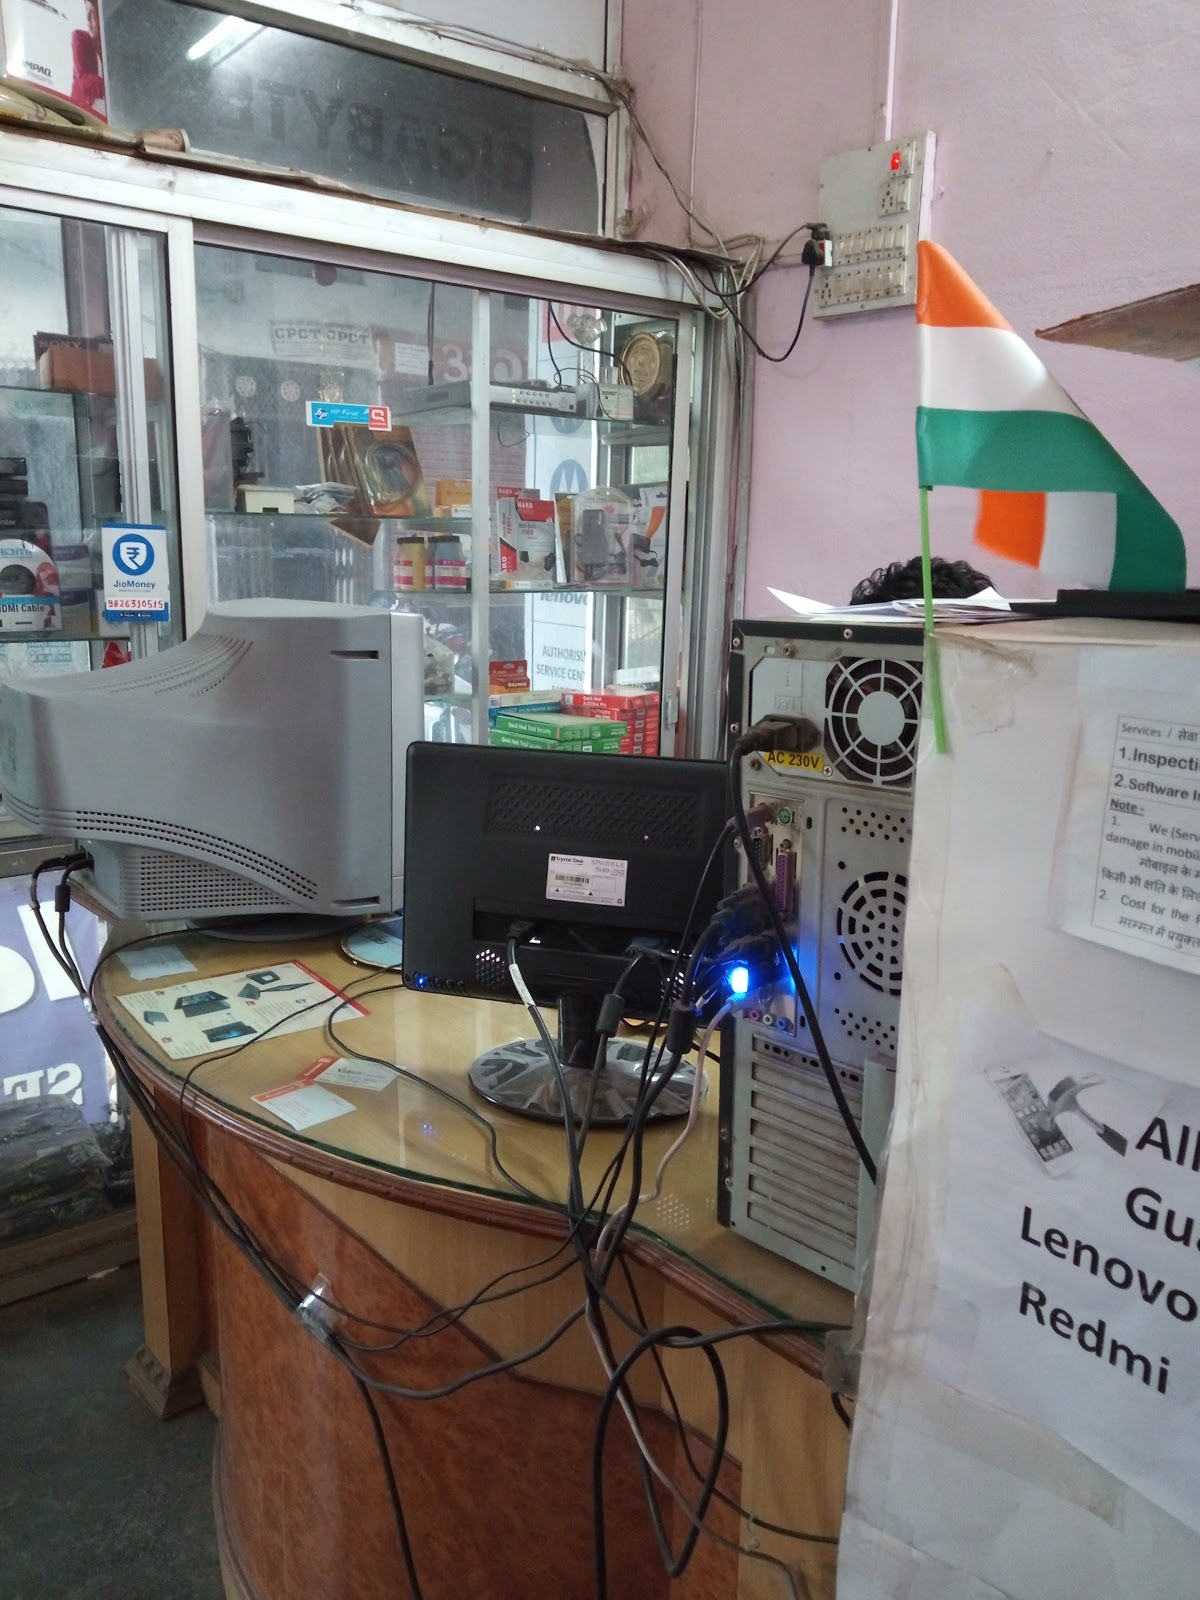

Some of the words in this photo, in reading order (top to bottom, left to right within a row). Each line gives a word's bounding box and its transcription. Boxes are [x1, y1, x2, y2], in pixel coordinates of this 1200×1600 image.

[23, 60, 52, 77] MPAQ
[39, 340, 81, 350] SONY
[113, 580, 156, 589] JioMoney
[0, 604, 19, 612] DMI
[22, 603, 45, 612] Cable
[536, 663, 566, 679] SERVICE
[1121, 723, 1161, 738] Services
[767, 752, 785, 764] AC
[788, 753, 820, 769] 230V
[1120, 746, 1200, 771] 1.Inspecti
[1110, 798, 1138, 813] Note
[1149, 822, 1168, 836] We
[1106, 832, 1150, 850] damage
[1152, 841, 1163, 853] in
[1166, 847, 1200, 861] mobil
[1121, 895, 1146, 911] Cost
[1151, 902, 1165, 915] for
[1170, 908, 1189, 922] the
[1125, 1187, 1200, 1253] Gu
[1021, 1205, 1198, 1323] Lenovo
[1019, 1281, 1170, 1396] Redmi
